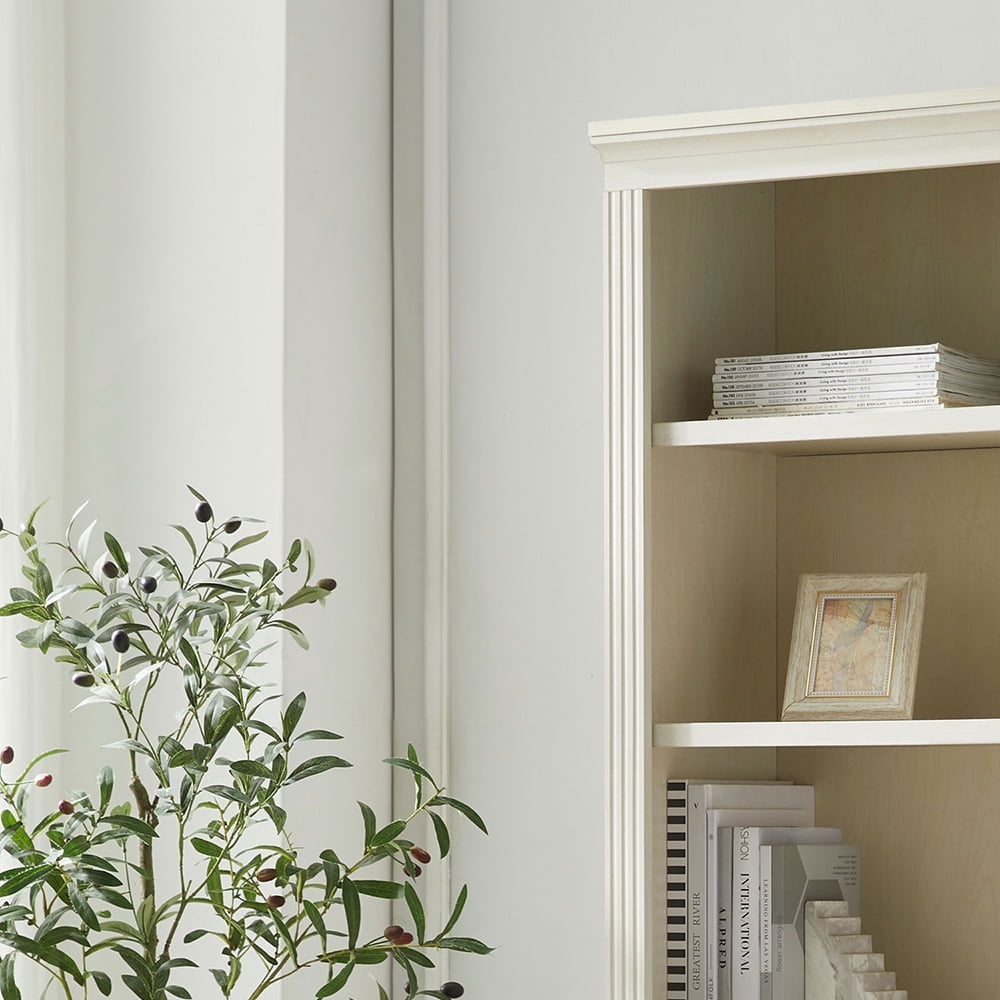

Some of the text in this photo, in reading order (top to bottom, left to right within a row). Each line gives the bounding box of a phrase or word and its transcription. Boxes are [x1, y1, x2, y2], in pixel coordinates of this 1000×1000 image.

[692, 892, 700, 991] GREATEST RIVER
[740, 873, 750, 975] INTERNATIONAL
